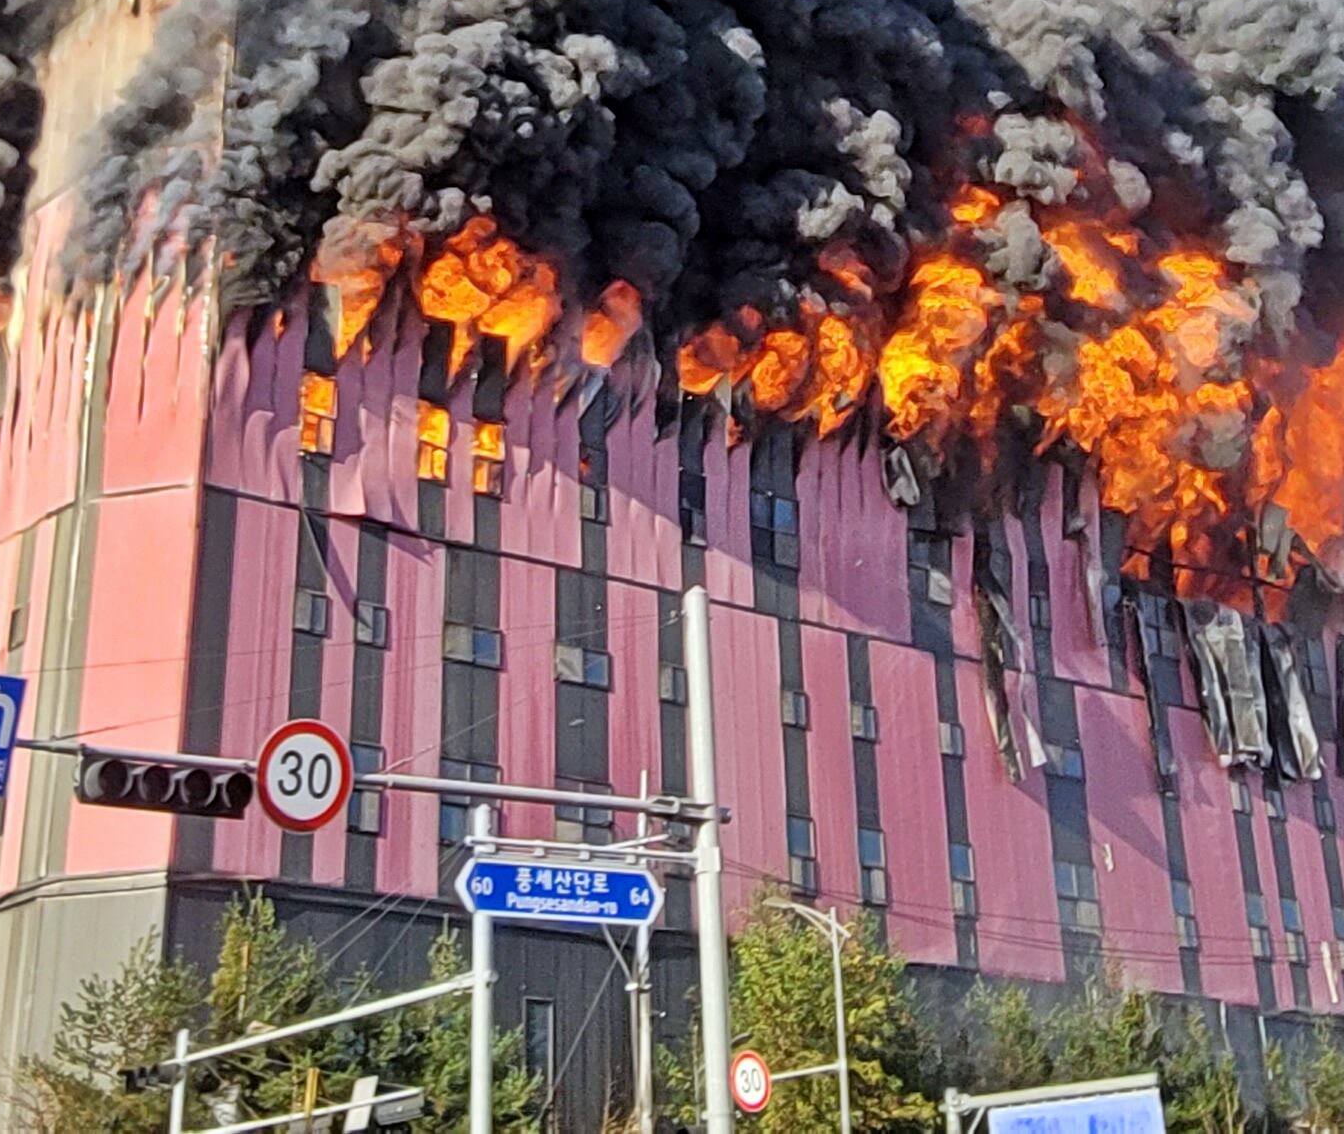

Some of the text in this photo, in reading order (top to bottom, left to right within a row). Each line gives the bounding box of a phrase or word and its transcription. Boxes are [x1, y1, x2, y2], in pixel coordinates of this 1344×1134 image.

[277, 749, 332, 799] 30
[470, 876, 494, 896] 60
[514, 867, 610, 896] 풍세산단로
[629, 887, 651, 906] 64
[739, 1067, 762, 1094] 30
